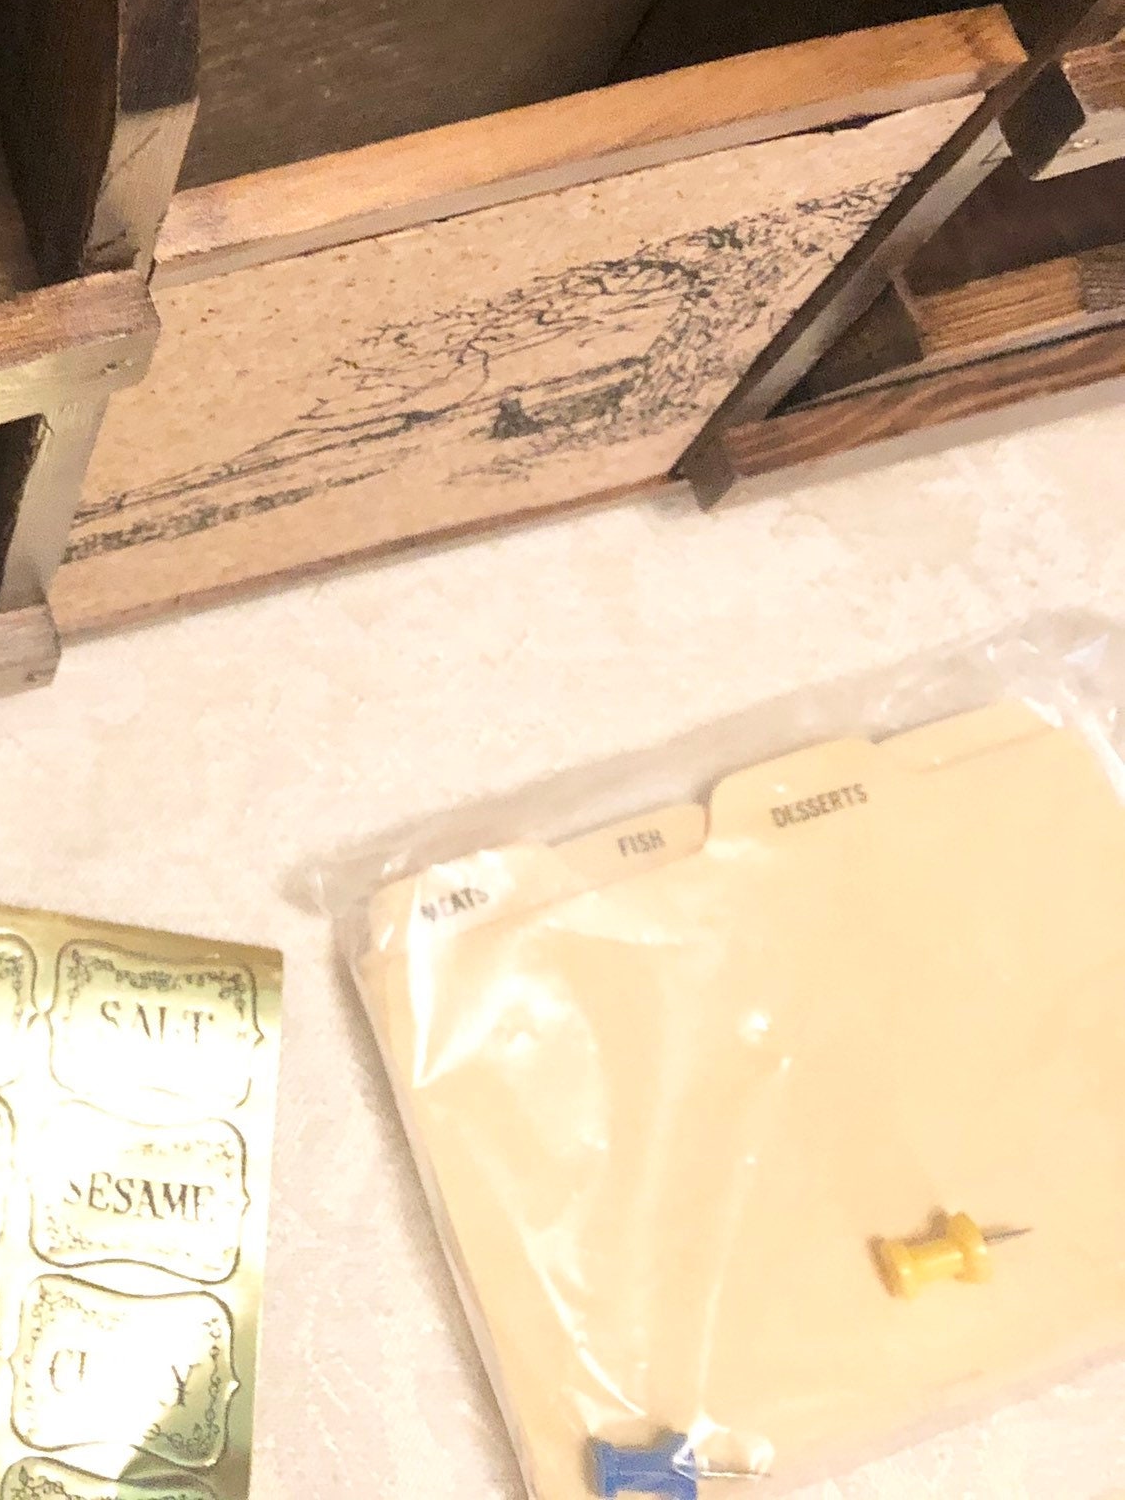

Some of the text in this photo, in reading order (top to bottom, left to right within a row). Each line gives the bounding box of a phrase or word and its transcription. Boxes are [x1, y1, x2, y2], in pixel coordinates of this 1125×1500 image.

[770, 783, 868, 828] DESSERTS
[617, 829, 666, 857] FISH
[63, 1171, 215, 1221] SESAME
